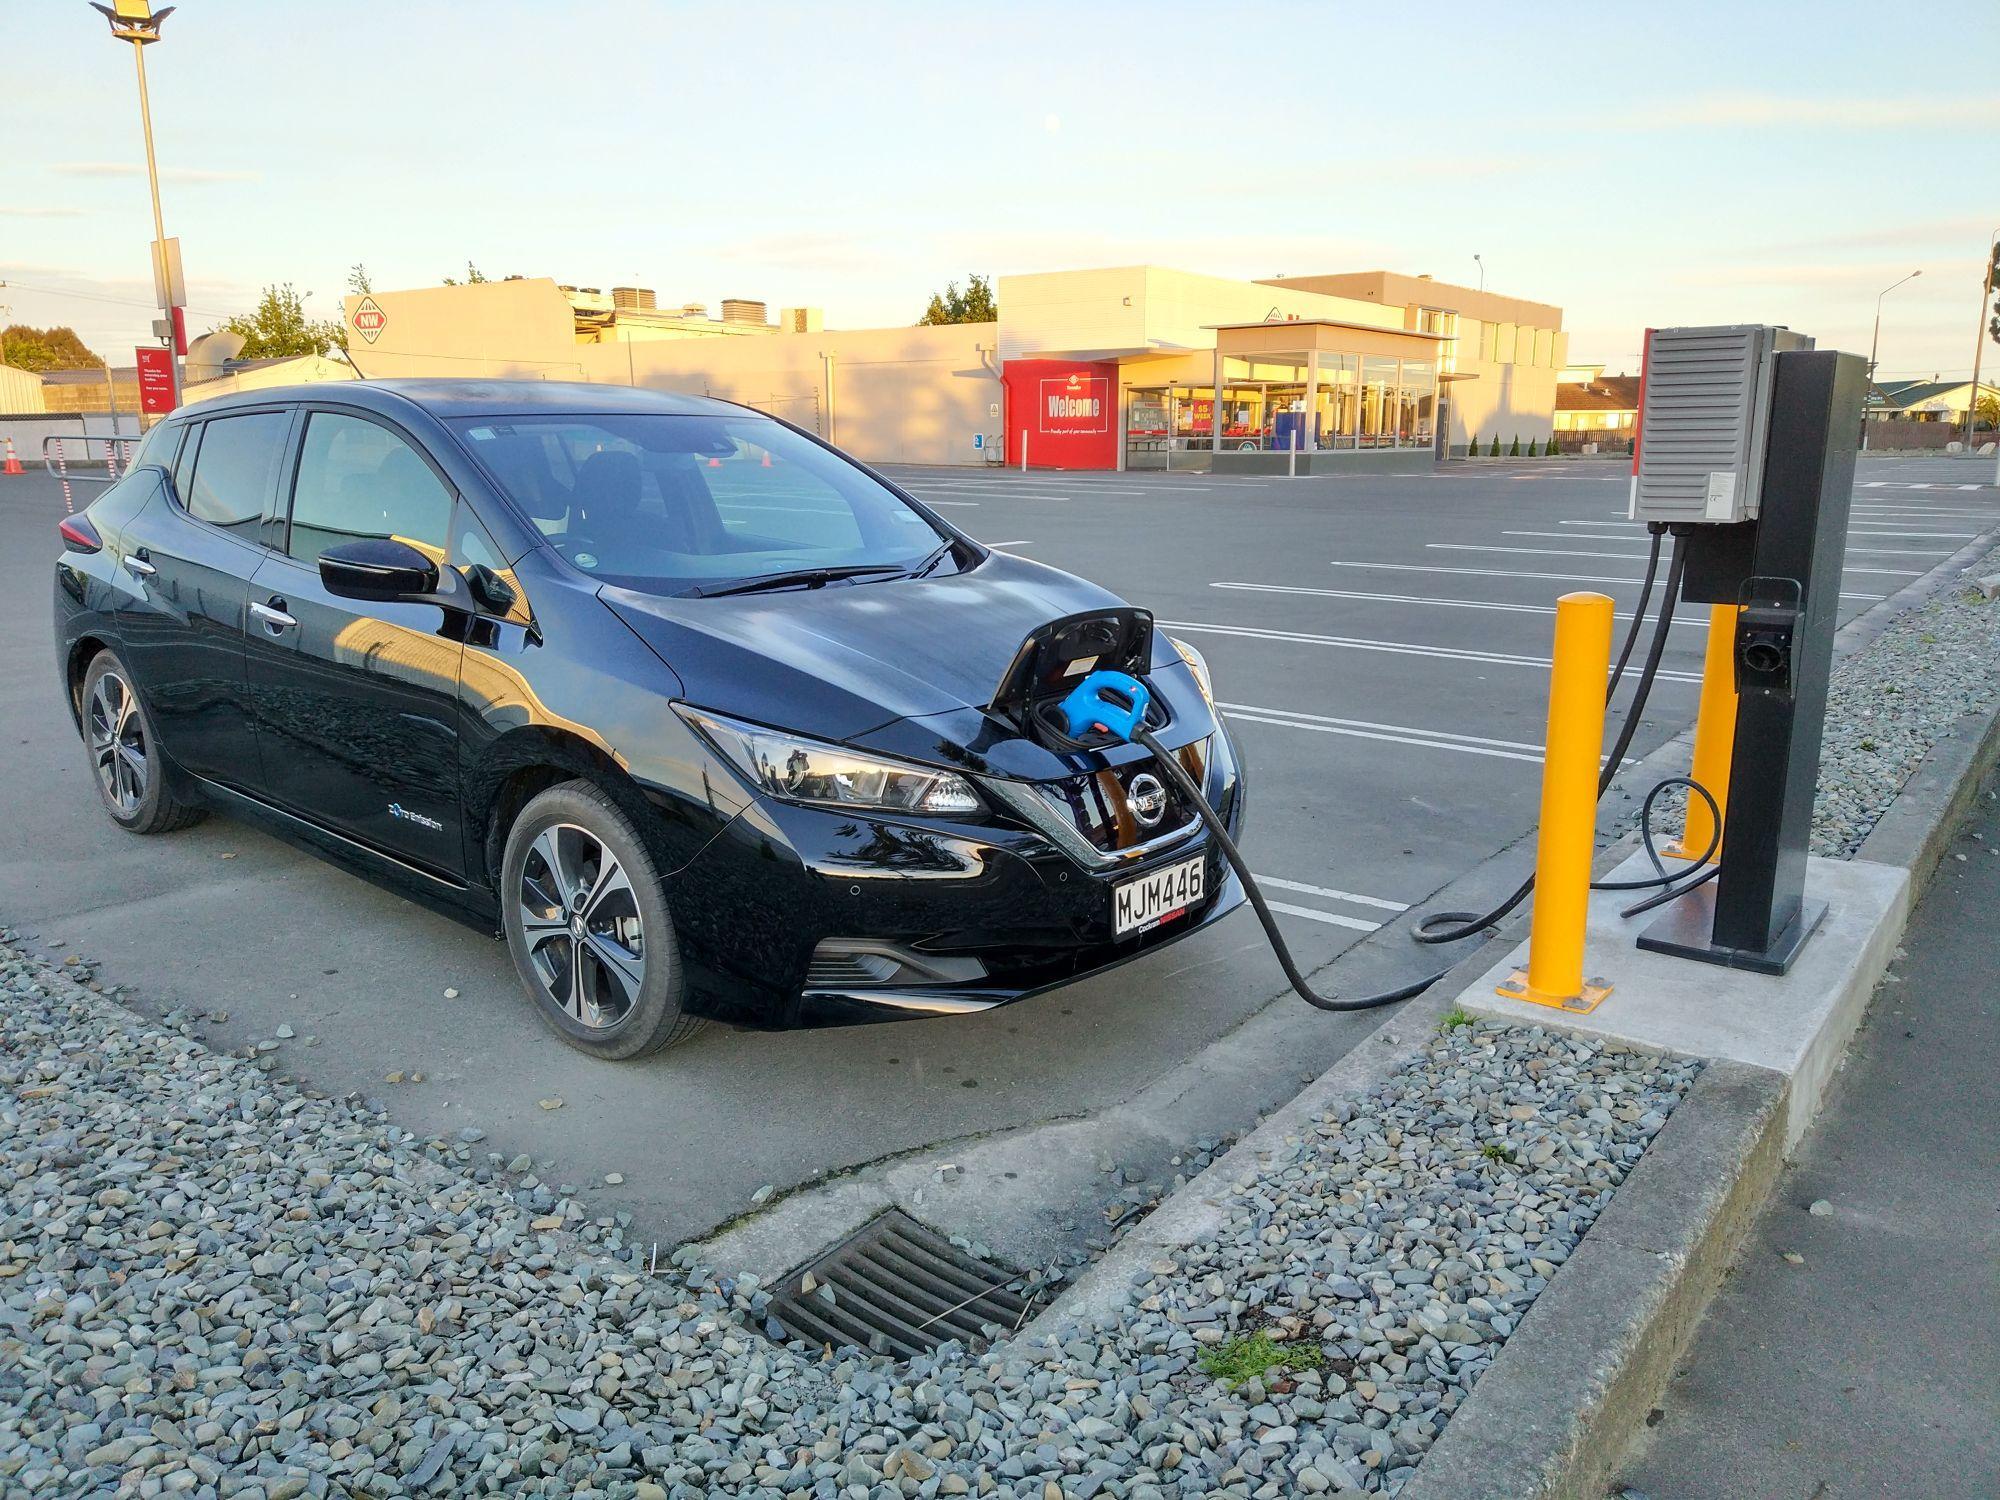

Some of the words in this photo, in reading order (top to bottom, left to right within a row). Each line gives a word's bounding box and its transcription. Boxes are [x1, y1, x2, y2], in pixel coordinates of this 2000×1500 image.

[360, 314, 379, 327] NW
[1048, 395, 1100, 418] Welcome
[1134, 792, 1166, 811] NISSAN
[1117, 861, 1201, 928] MJM446
